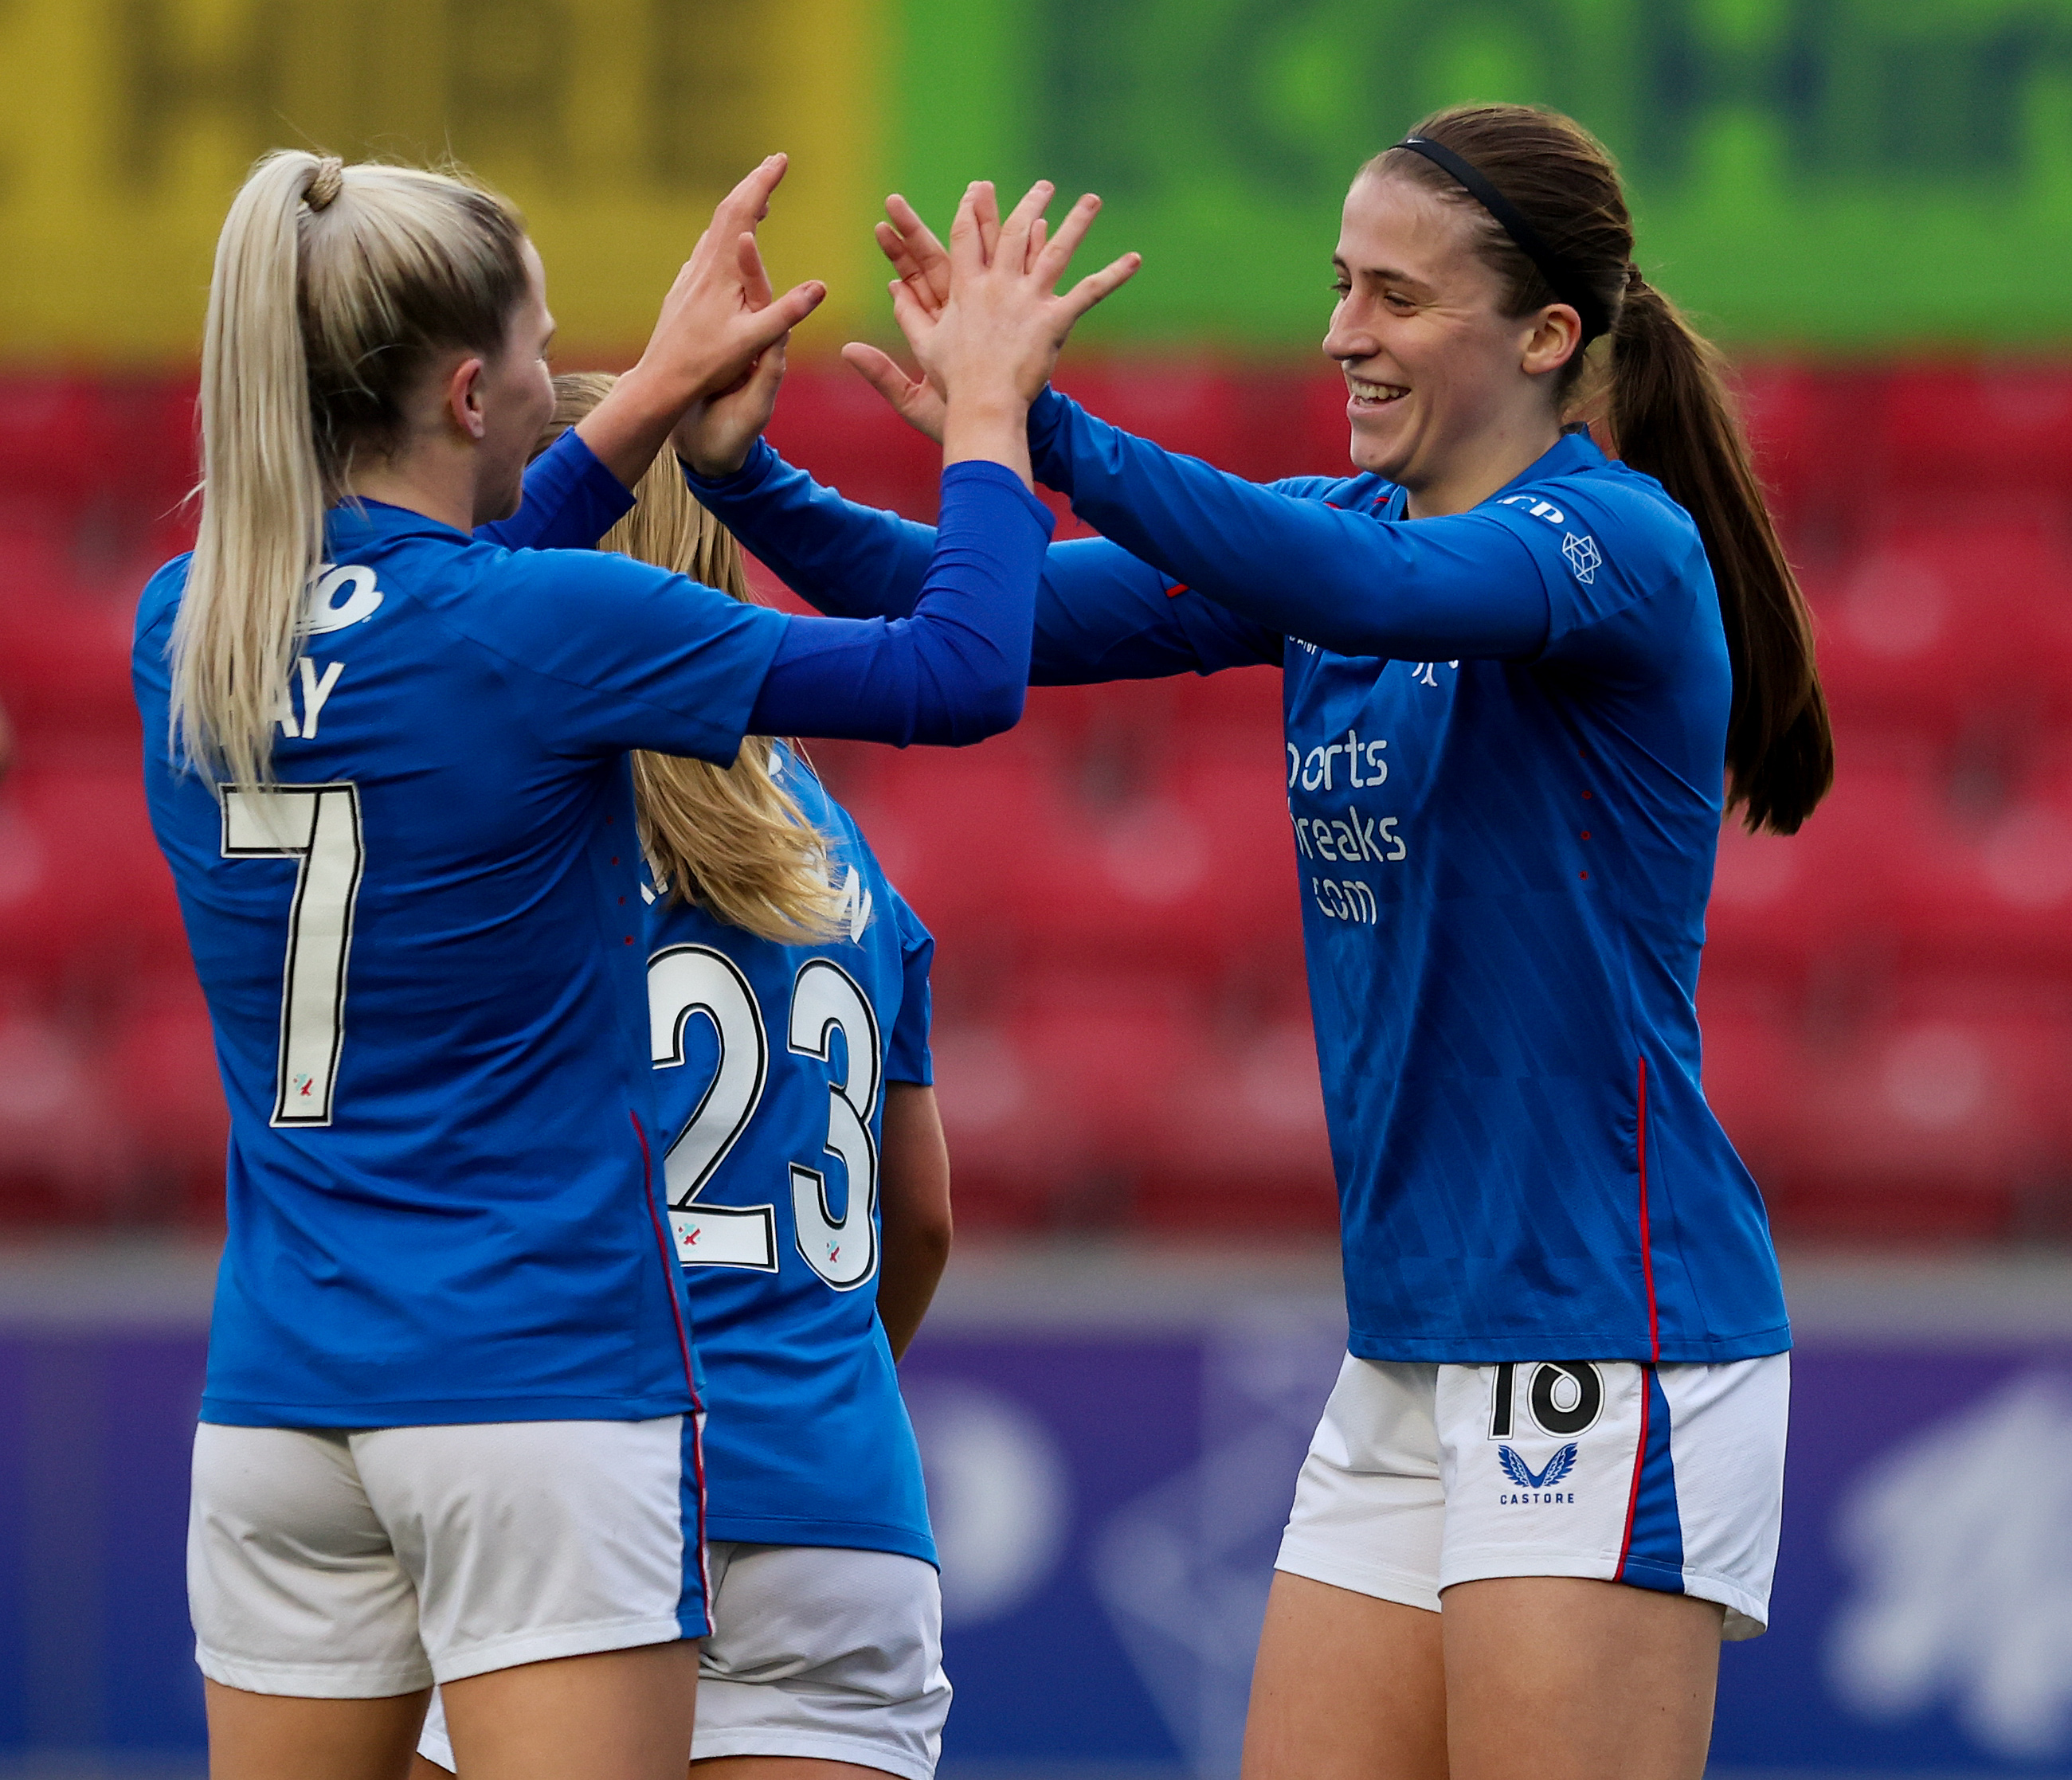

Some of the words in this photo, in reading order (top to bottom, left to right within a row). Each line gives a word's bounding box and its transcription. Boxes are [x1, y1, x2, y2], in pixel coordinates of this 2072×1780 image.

[265, 655, 346, 745] AY
[1288, 800, 1407, 863] reaks
[221, 780, 365, 1129] 7
[646, 941, 881, 1293] 23
[1499, 1493, 1575, 1505] CASTORE
